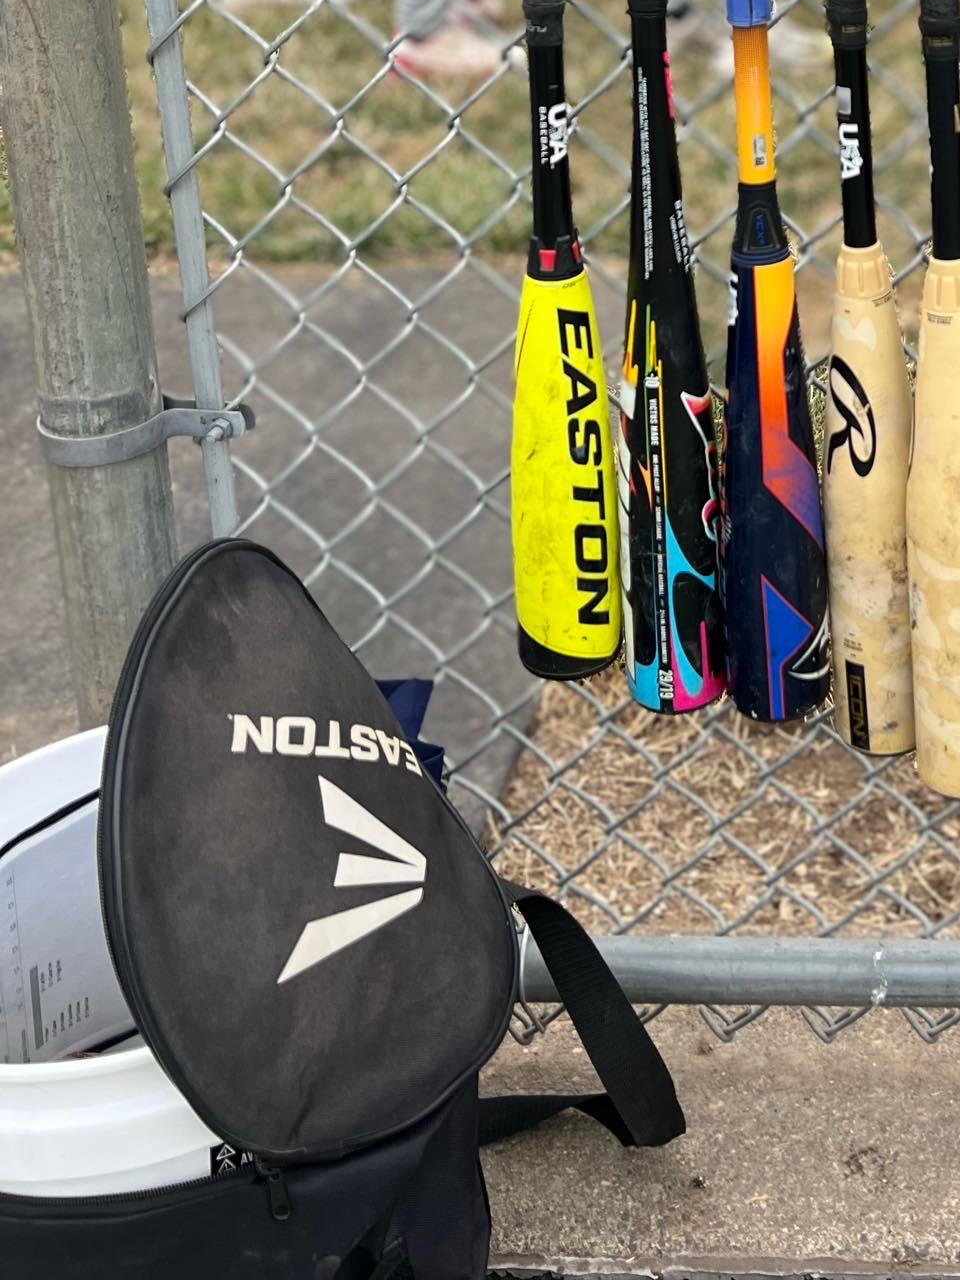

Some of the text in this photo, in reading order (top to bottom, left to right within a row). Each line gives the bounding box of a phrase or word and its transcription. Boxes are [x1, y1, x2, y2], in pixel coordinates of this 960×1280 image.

[539, 105, 548, 166] BASEBALL
[548, 102, 576, 166] USA
[839, 123, 863, 180] USA
[649, 398, 657, 424] VICTUS
[650, 425, 659, 446] MADE
[556, 307, 611, 626] EASTON
[659, 668, 674, 701] 29/19
[850, 674, 865, 737] ICON
[228, 713, 423, 777] EASTON
